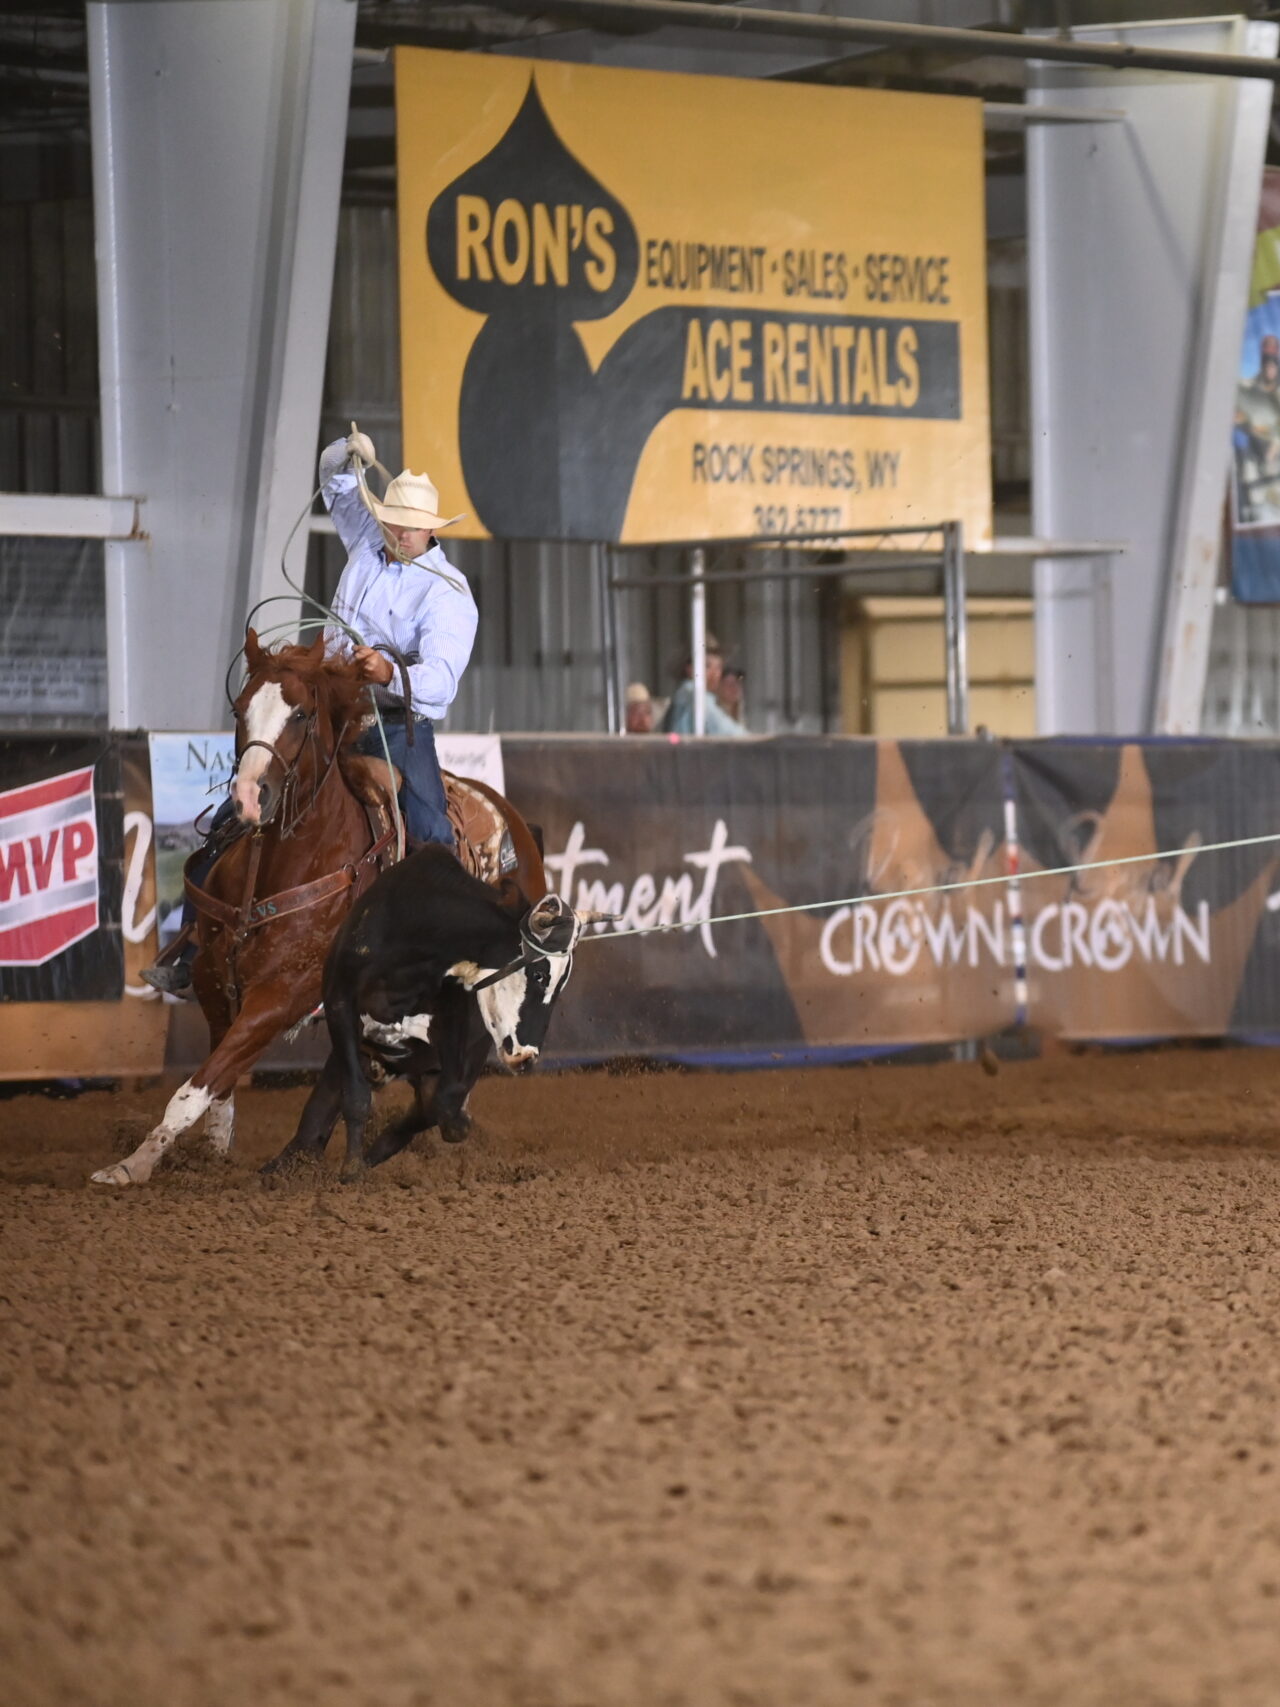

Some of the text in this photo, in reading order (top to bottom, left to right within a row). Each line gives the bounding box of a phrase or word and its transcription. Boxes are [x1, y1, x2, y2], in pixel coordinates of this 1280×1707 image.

[456, 194, 617, 292] RON'S
[646, 239, 950, 305] EQUIPMENT SALES SERVICE
[682, 318, 920, 408] ACE RENTALS
[692, 443, 900, 494] ROCK SPRINGS, WY
[0, 820, 95, 902] MVP
[543, 818, 752, 958] tment
[820, 899, 1003, 976] CROWN
[1032, 899, 1210, 972] CROWN
